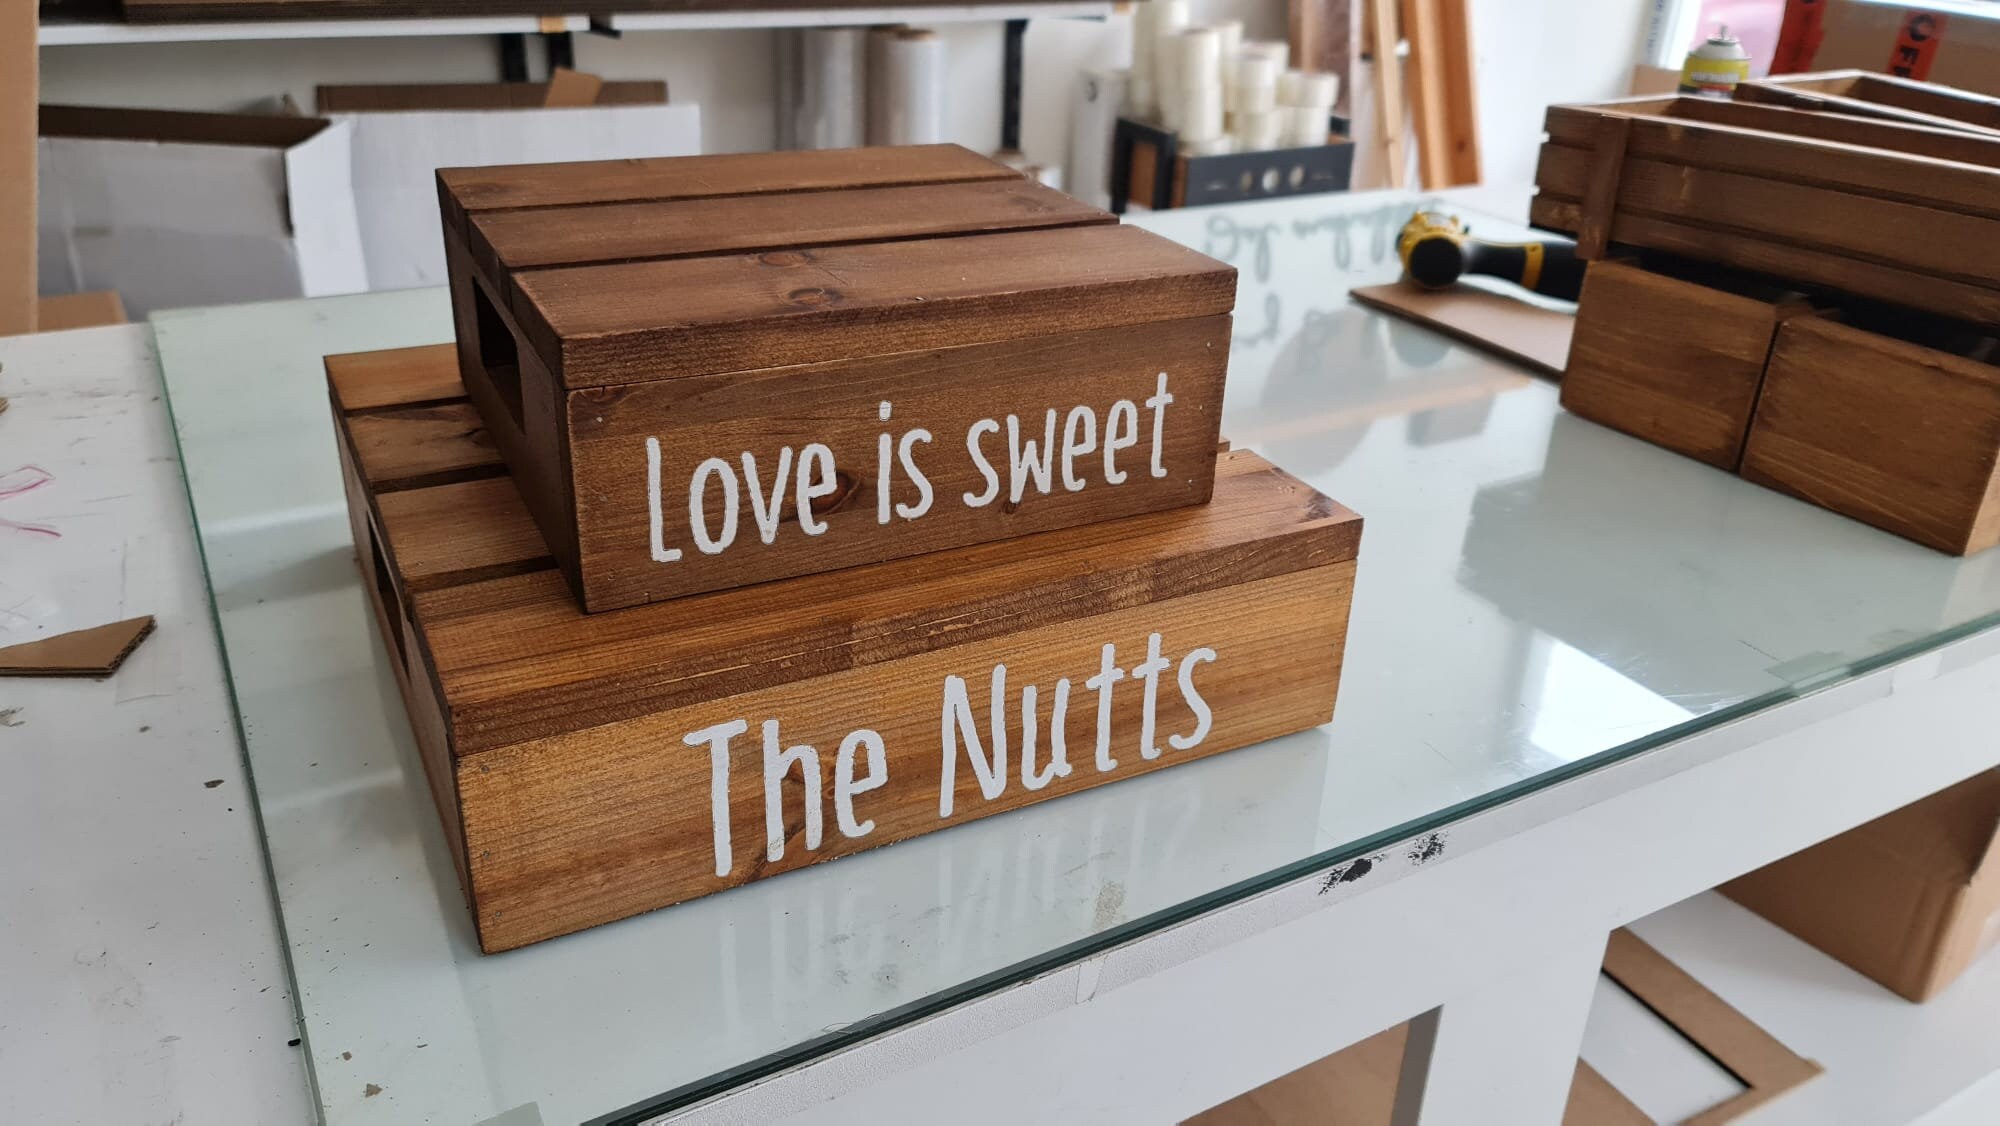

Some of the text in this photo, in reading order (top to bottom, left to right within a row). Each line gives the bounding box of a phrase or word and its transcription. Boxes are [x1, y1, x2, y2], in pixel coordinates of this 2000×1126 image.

[645, 372, 1174, 563] Love is sweet
[682, 632, 1217, 877] The Nutts
